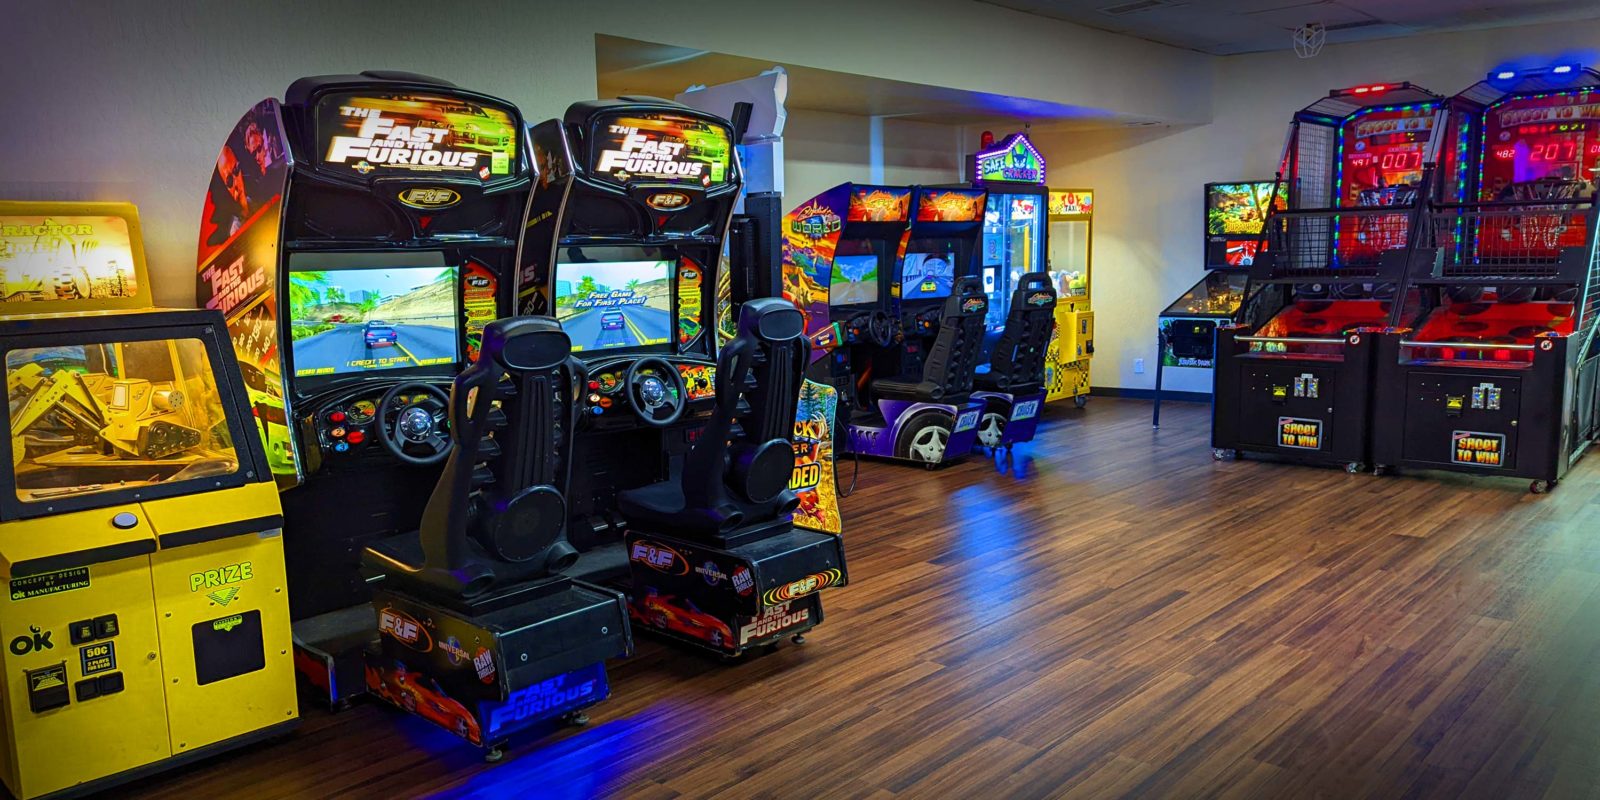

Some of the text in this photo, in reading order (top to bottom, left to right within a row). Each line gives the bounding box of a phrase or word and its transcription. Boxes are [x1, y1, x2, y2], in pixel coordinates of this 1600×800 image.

[342, 106, 382, 119] THE
[1580, 103, 1600, 118] WI
[358, 117, 450, 144] FAST
[609, 124, 639, 135] THE
[328, 136, 479, 167] FURIOUS
[371, 140, 433, 150] AND THE
[621, 134, 685, 156] FAST
[1497, 149, 1515, 158] 482
[1531, 141, 1576, 161] 207
[598, 149, 703, 175] FURIOUS
[629, 152, 673, 162] AND THE
[1382, 152, 1420, 169] 007
[984, 157, 1006, 175] SAFE
[1003, 167, 1038, 180] CRACKER
[407, 187, 452, 204] F&F
[652, 193, 684, 206] F&F
[0, 223, 94, 237] RACTOR
[792, 217, 842, 235] WORLD
[202, 265, 216, 282] THE
[211, 256, 245, 297] FAST
[206, 266, 265, 314] FURIOUS
[589, 290, 633, 299] FREE GAME
[575, 296, 647, 308] FOR FIRST PLACE!
[351, 358, 377, 367] CREDIT
[1283, 423, 1317, 436] SHOOT
[1282, 434, 1318, 448] TO WIN
[1458, 437, 1499, 451] SHOOT
[1457, 449, 1499, 464] TO WIN
[789, 464, 819, 491] DED
[631, 544, 674, 567] F&F
[12, 576, 45, 587] CONCEPT
[58, 569, 86, 579] DESIGN
[190, 562, 253, 592] PRIZE
[695, 566, 728, 580] UNIVERSAL
[731, 568, 751, 587] RAW
[27, 581, 89, 597] MANUFACTURING
[736, 579, 754, 592] THRILLS
[789, 577, 817, 597] F&F
[380, 611, 418, 641] F&F
[740, 608, 809, 645] FURIOUS
[86, 646, 108, 658] 50¢
[439, 641, 471, 660] UNIVERSAL
[473, 649, 492, 672] RAW
[477, 664, 496, 680] THRILLS
[489, 680, 593, 733] FURIOUS
